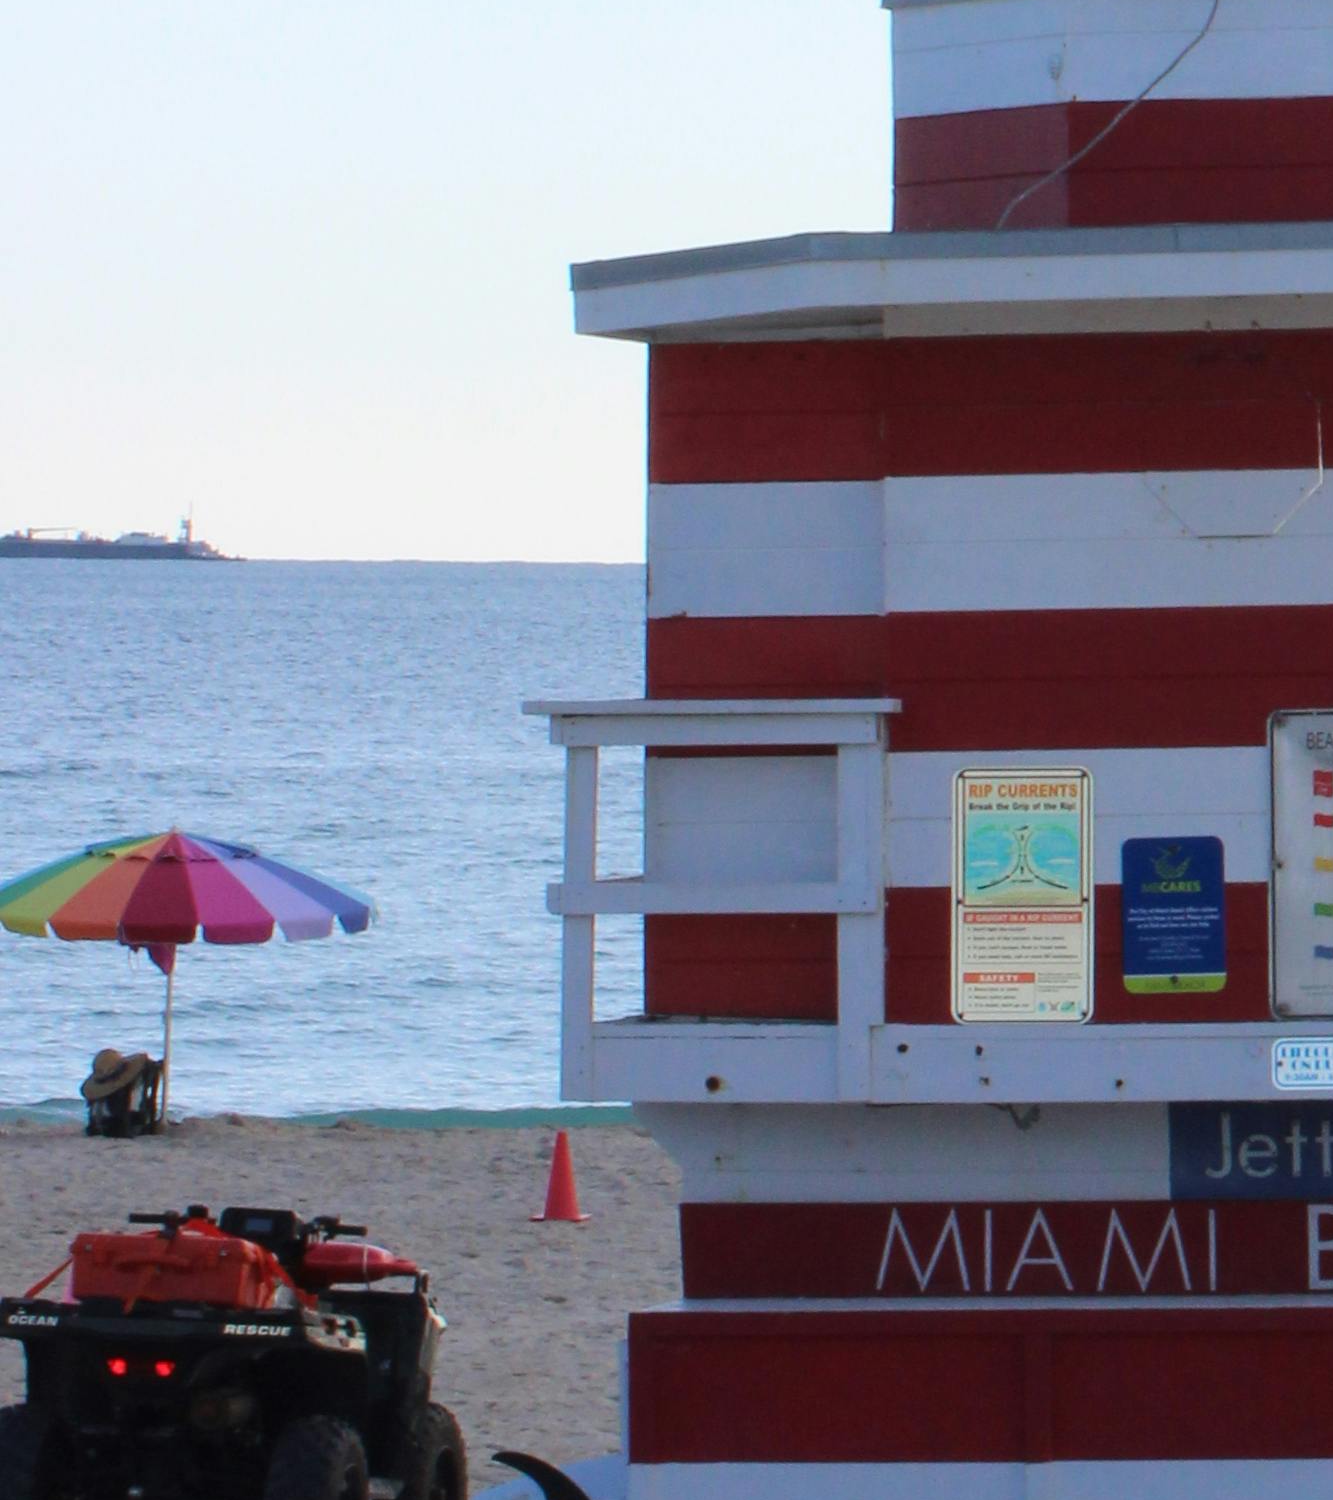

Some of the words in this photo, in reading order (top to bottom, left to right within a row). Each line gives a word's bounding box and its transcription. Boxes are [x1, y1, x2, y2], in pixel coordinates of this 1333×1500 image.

[968, 784, 992, 798] RIP
[997, 783, 1078, 798] CURRENTS
[876, 1207, 1217, 1292] MIAMI
[8, 1314, 59, 1327] OCEAN
[223, 1323, 292, 1337] RESCUE
